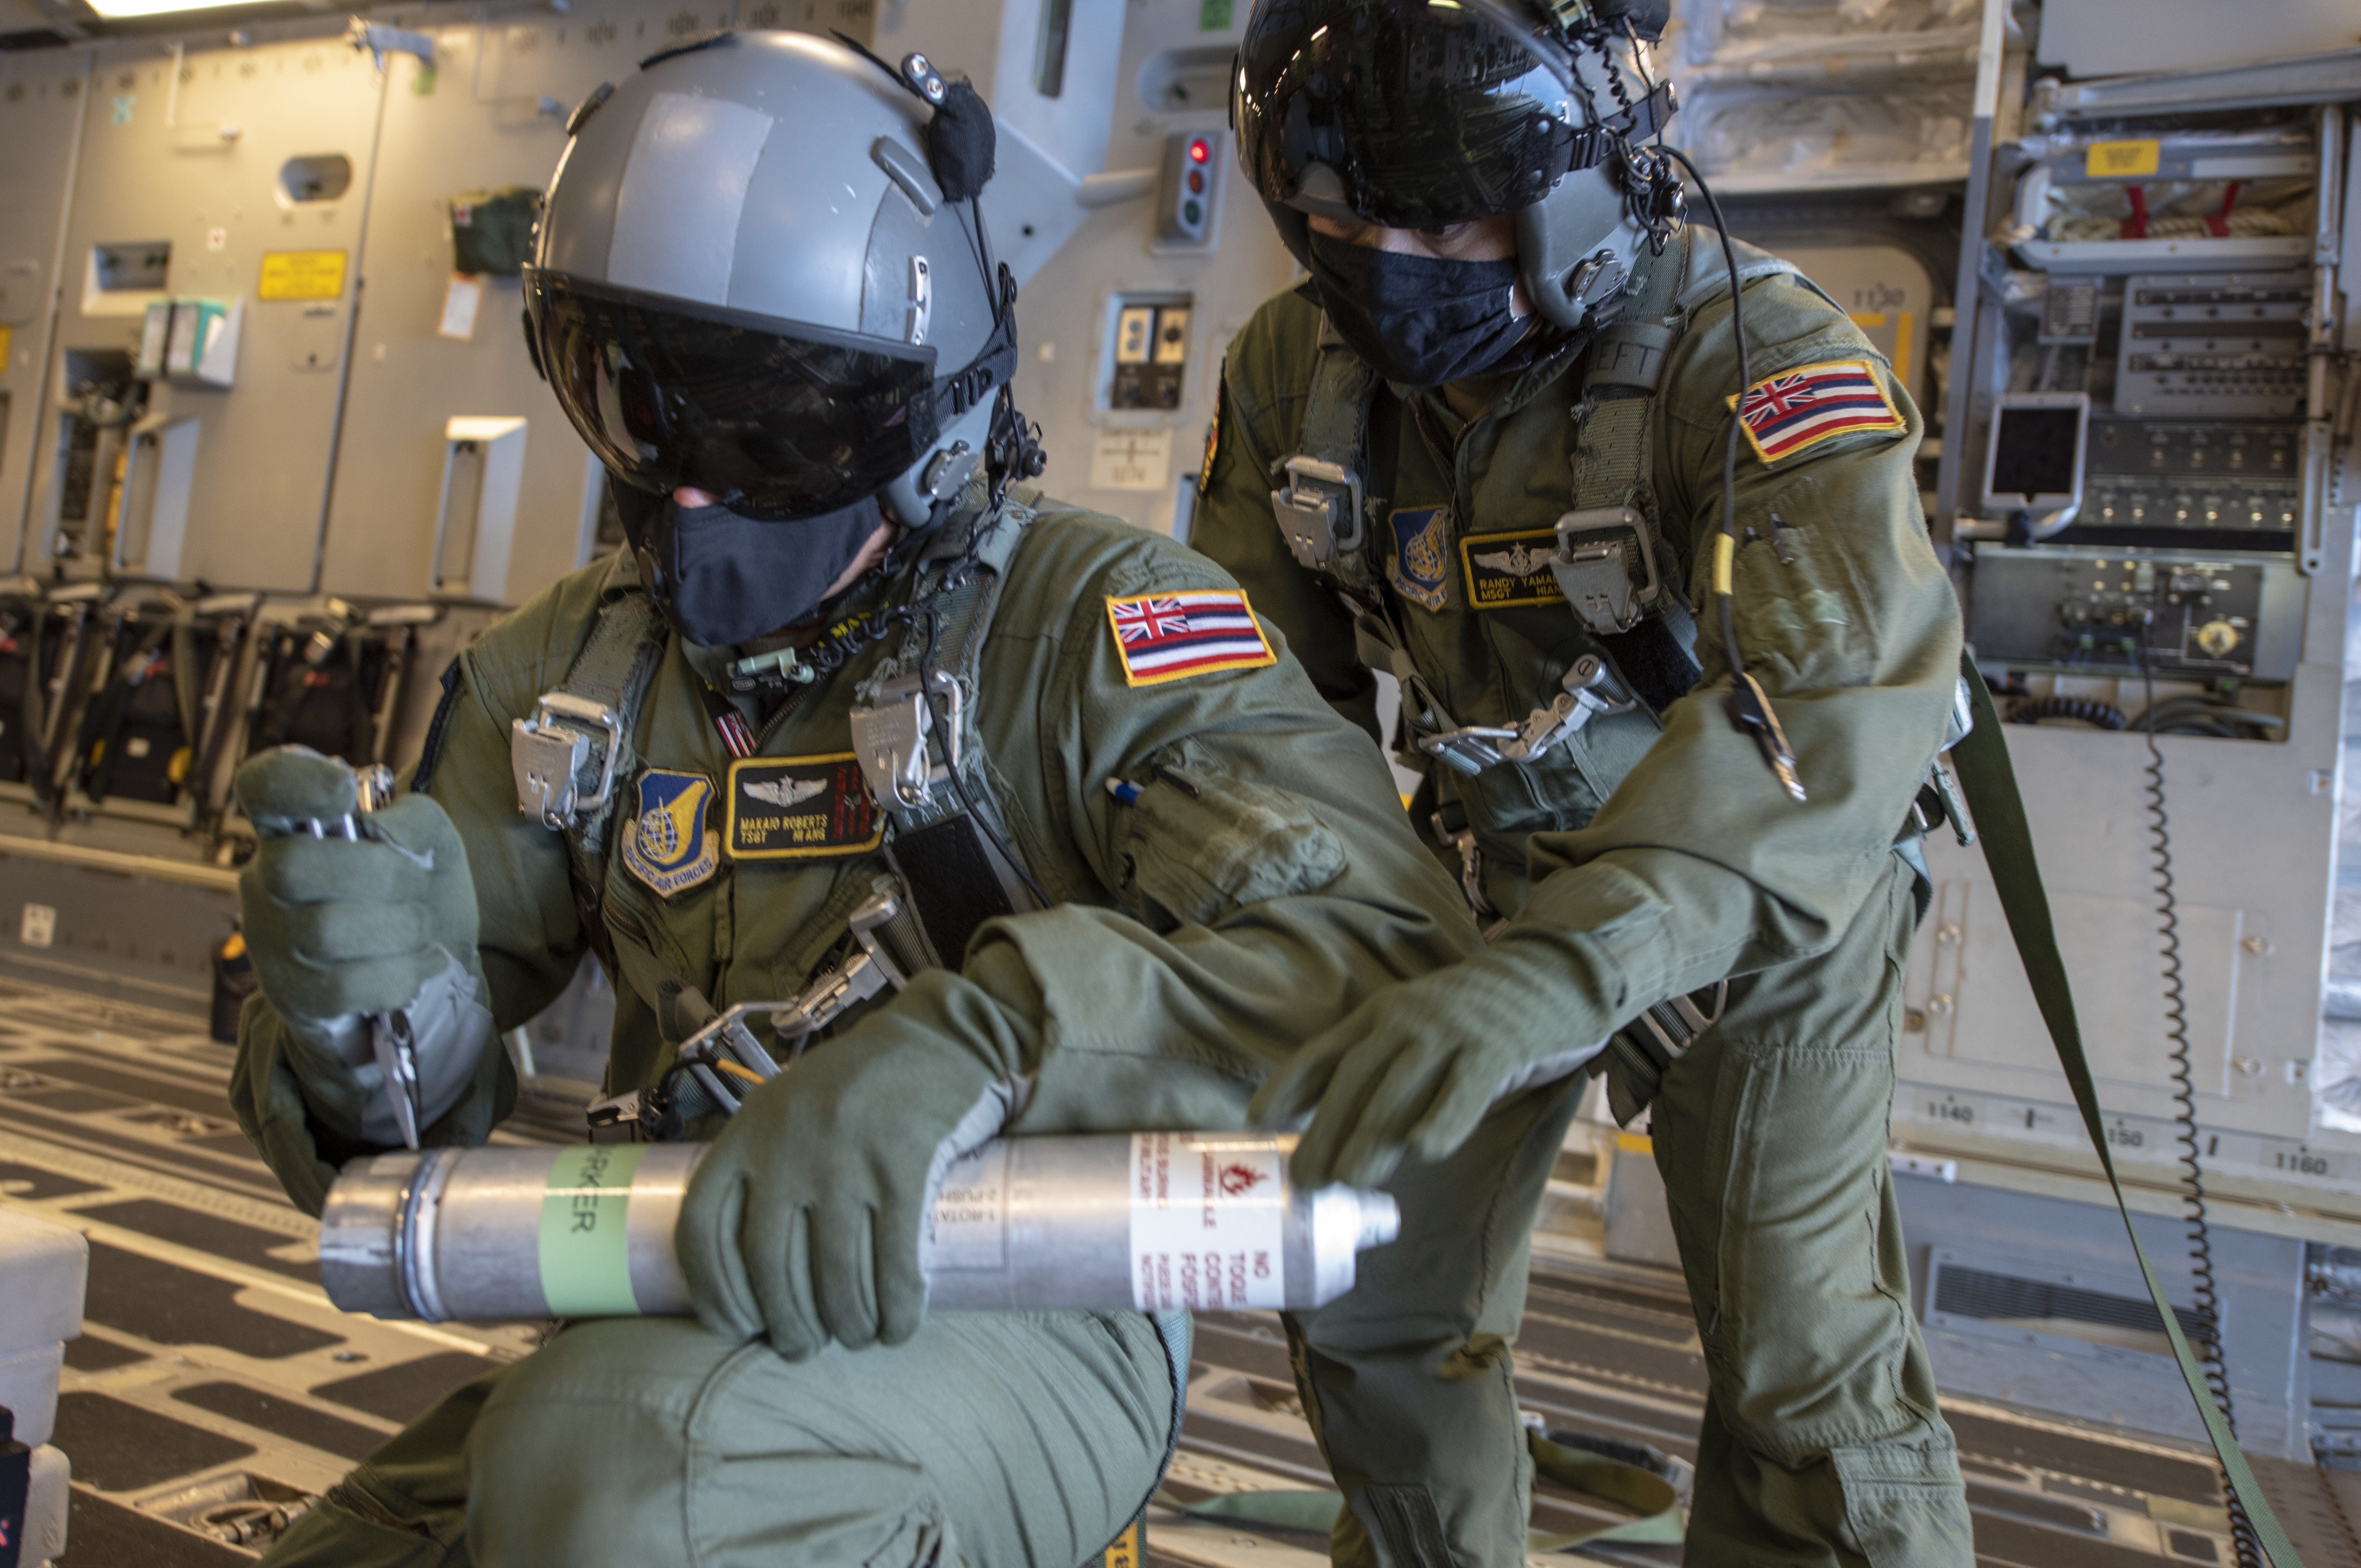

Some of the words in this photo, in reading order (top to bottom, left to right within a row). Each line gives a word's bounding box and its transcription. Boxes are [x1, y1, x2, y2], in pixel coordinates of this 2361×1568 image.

[1394, 575, 1423, 600] PACIFIC
[1425, 594, 1441, 608] AIR
[1479, 577, 1516, 590] RANDY
[1481, 587, 1511, 601] MSGT
[1536, 585, 1563, 597] HIAN
[740, 816, 780, 831] MAKAIO
[783, 814, 828, 831] ROBERTS
[740, 829, 767, 844] TSGT
[624, 845, 654, 882] PACIFIC
[655, 877, 672, 891] AIR
[673, 857, 713, 886] FORCES
[1928, 1101, 1974, 1125] 1140
[2108, 1127, 2144, 1148] 150
[2276, 1152, 2328, 1176] 1160
[571, 1151, 612, 1234] RKER
[1254, 1250, 1270, 1279] NO
